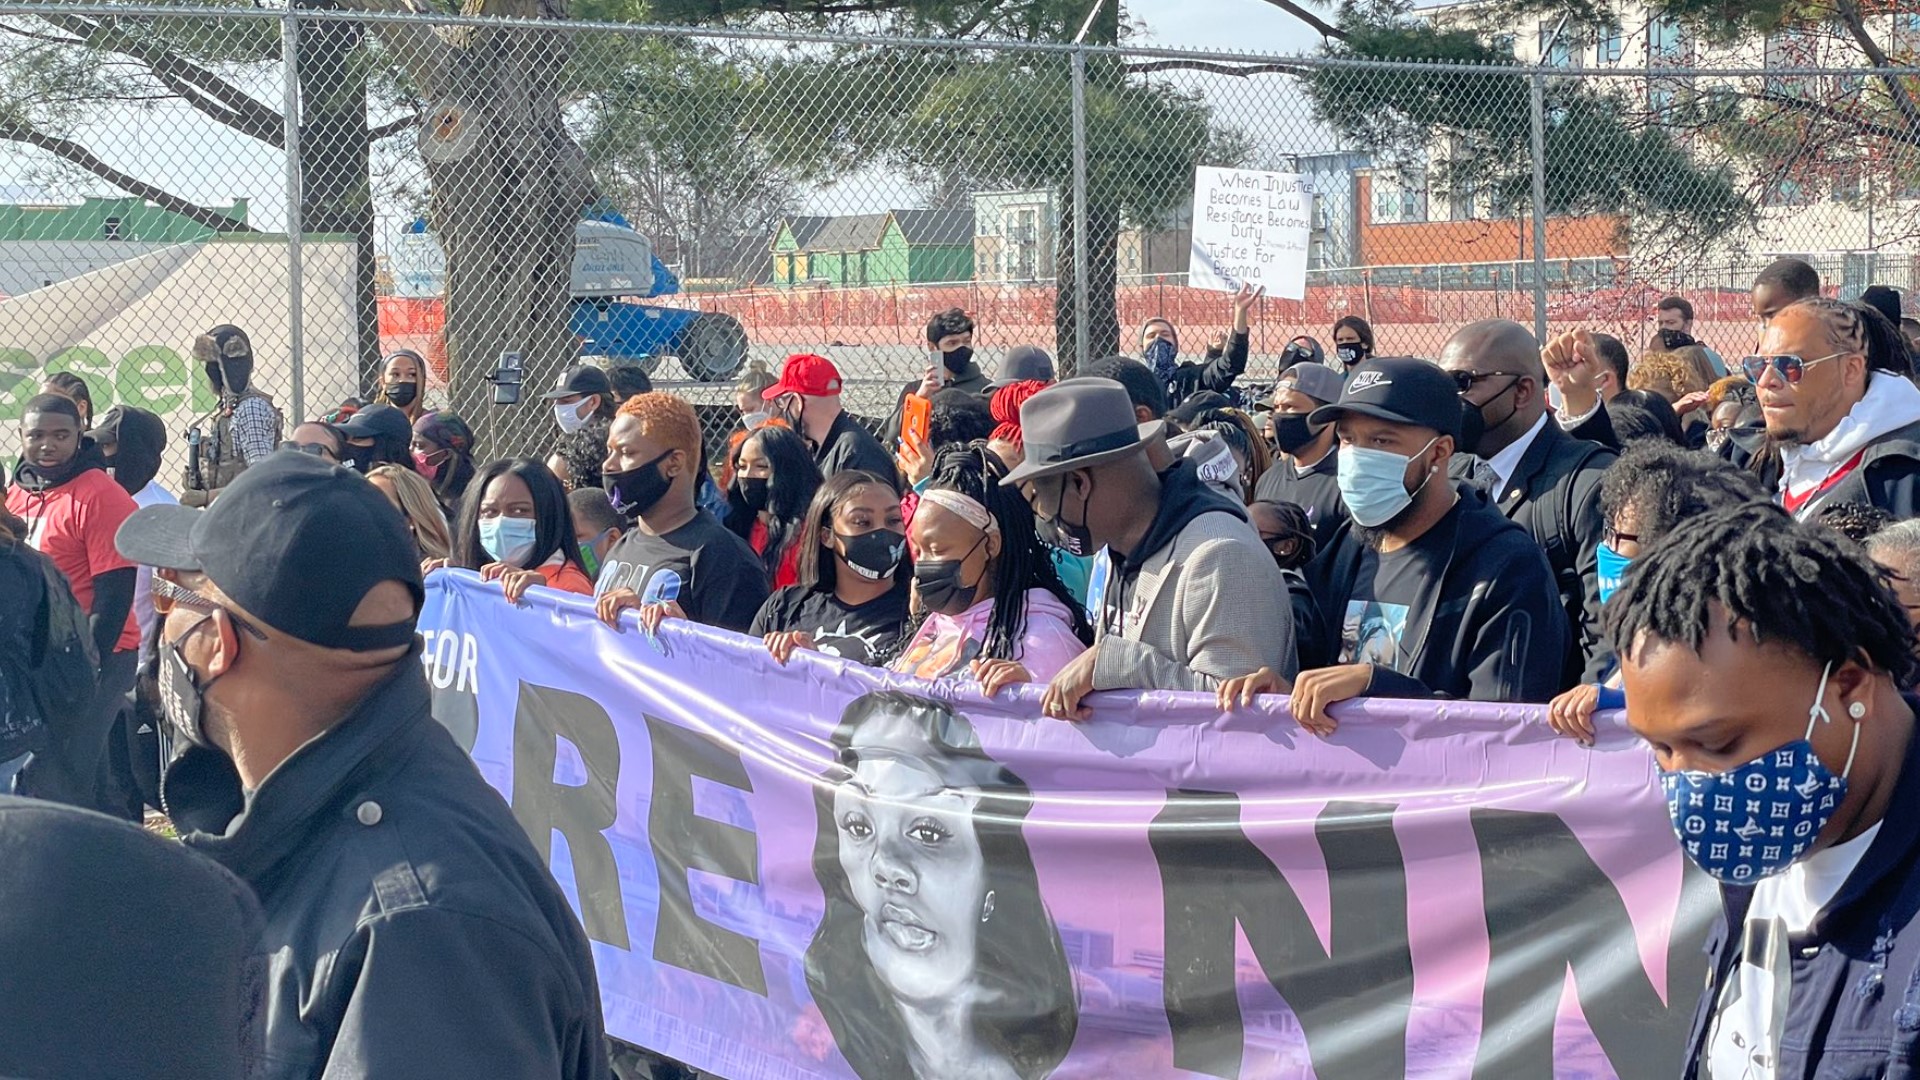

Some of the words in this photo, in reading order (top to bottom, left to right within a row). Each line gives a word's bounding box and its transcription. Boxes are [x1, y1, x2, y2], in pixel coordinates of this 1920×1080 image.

[1218, 172, 1260, 189] When
[1210, 188, 1262, 207] Becomes
[1268, 195, 1300, 211] Law
[1206, 205, 1263, 223] Resistance
[1268, 211, 1309, 228] Becomes
[1231, 224, 1263, 247] Duty
[1207, 242, 1248, 260] Justice
[1255, 248, 1275, 263] For
[1222, 277, 1258, 294] Taylr
[424, 629, 479, 694] FOR
